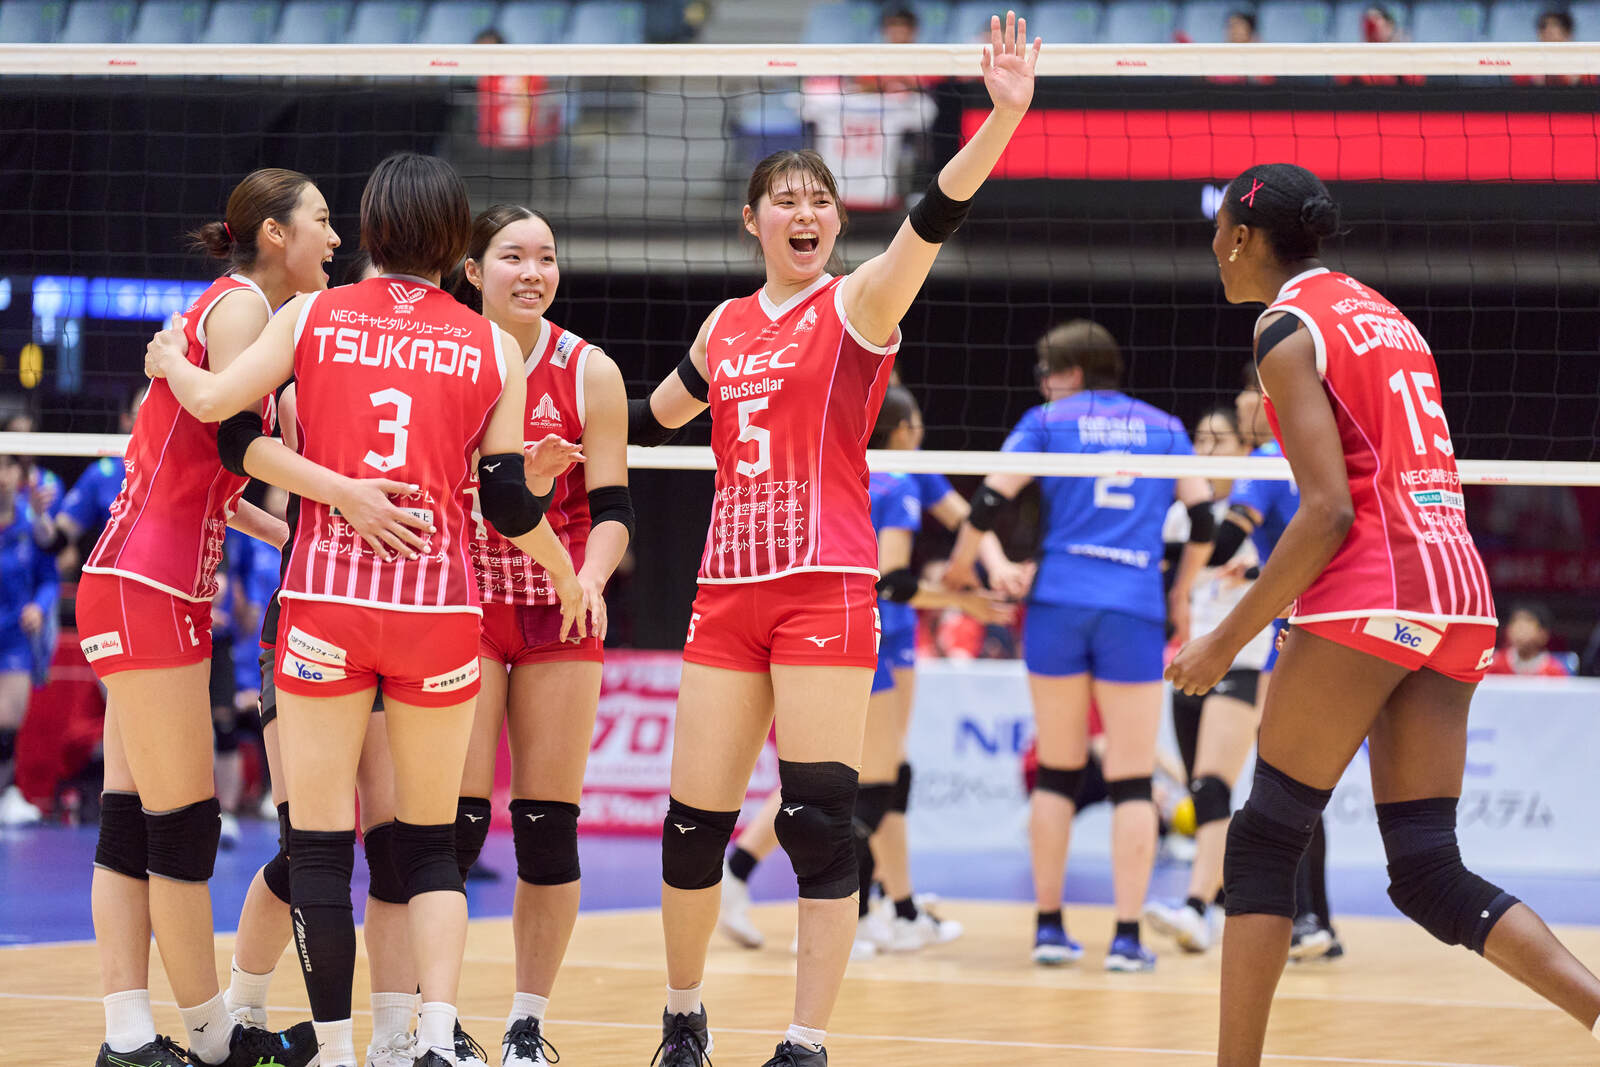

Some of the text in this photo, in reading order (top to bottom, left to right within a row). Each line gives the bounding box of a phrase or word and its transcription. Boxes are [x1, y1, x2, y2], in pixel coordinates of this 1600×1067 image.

[330, 309, 472, 338] NECキャピタルソリューション
[313, 326, 482, 384] TSUKADA
[713, 343, 799, 382] NEC
[720, 377, 785, 401] BluStellar
[1388, 368, 1455, 458] 15
[363, 387, 412, 473] 3
[736, 396, 771, 479] 5
[716, 480, 809, 503] NECネッツエスアイ
[716, 498, 803, 521] NEC航空宇宙システム
[715, 517, 805, 540] NECプラットフォームズ
[686, 612, 701, 644] 5
[1393, 622, 1423, 648] Yec
[294, 661, 324, 681] Yec
